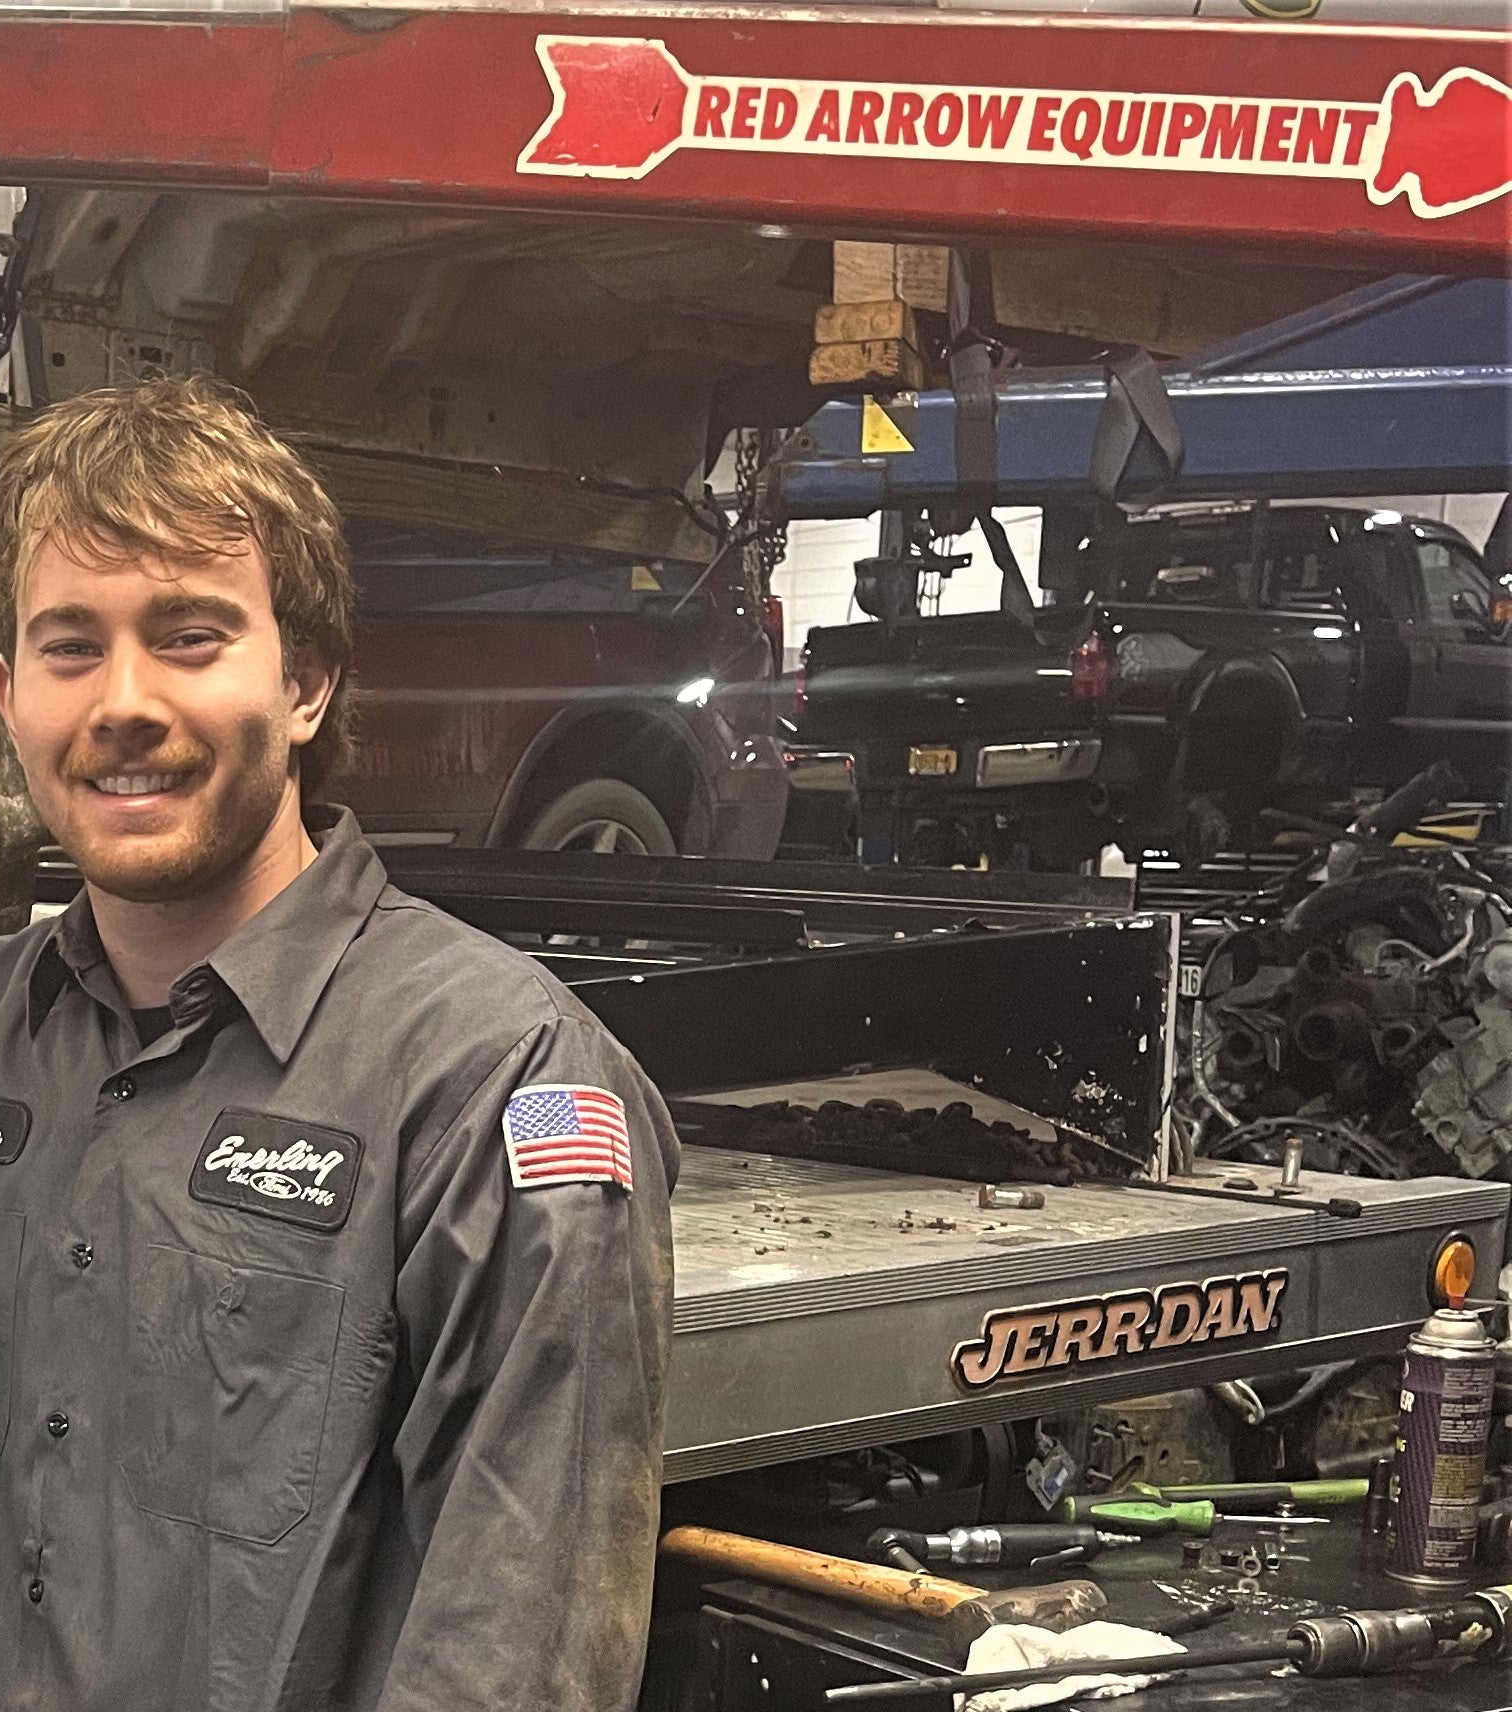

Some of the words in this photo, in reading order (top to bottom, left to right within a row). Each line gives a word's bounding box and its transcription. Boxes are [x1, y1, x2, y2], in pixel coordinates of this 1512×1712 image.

[693, 85, 798, 140] RED
[804, 88, 1024, 149] ARROW
[1027, 97, 1379, 166] EQUIPMENT
[204, 1135, 345, 1187] Emerling
